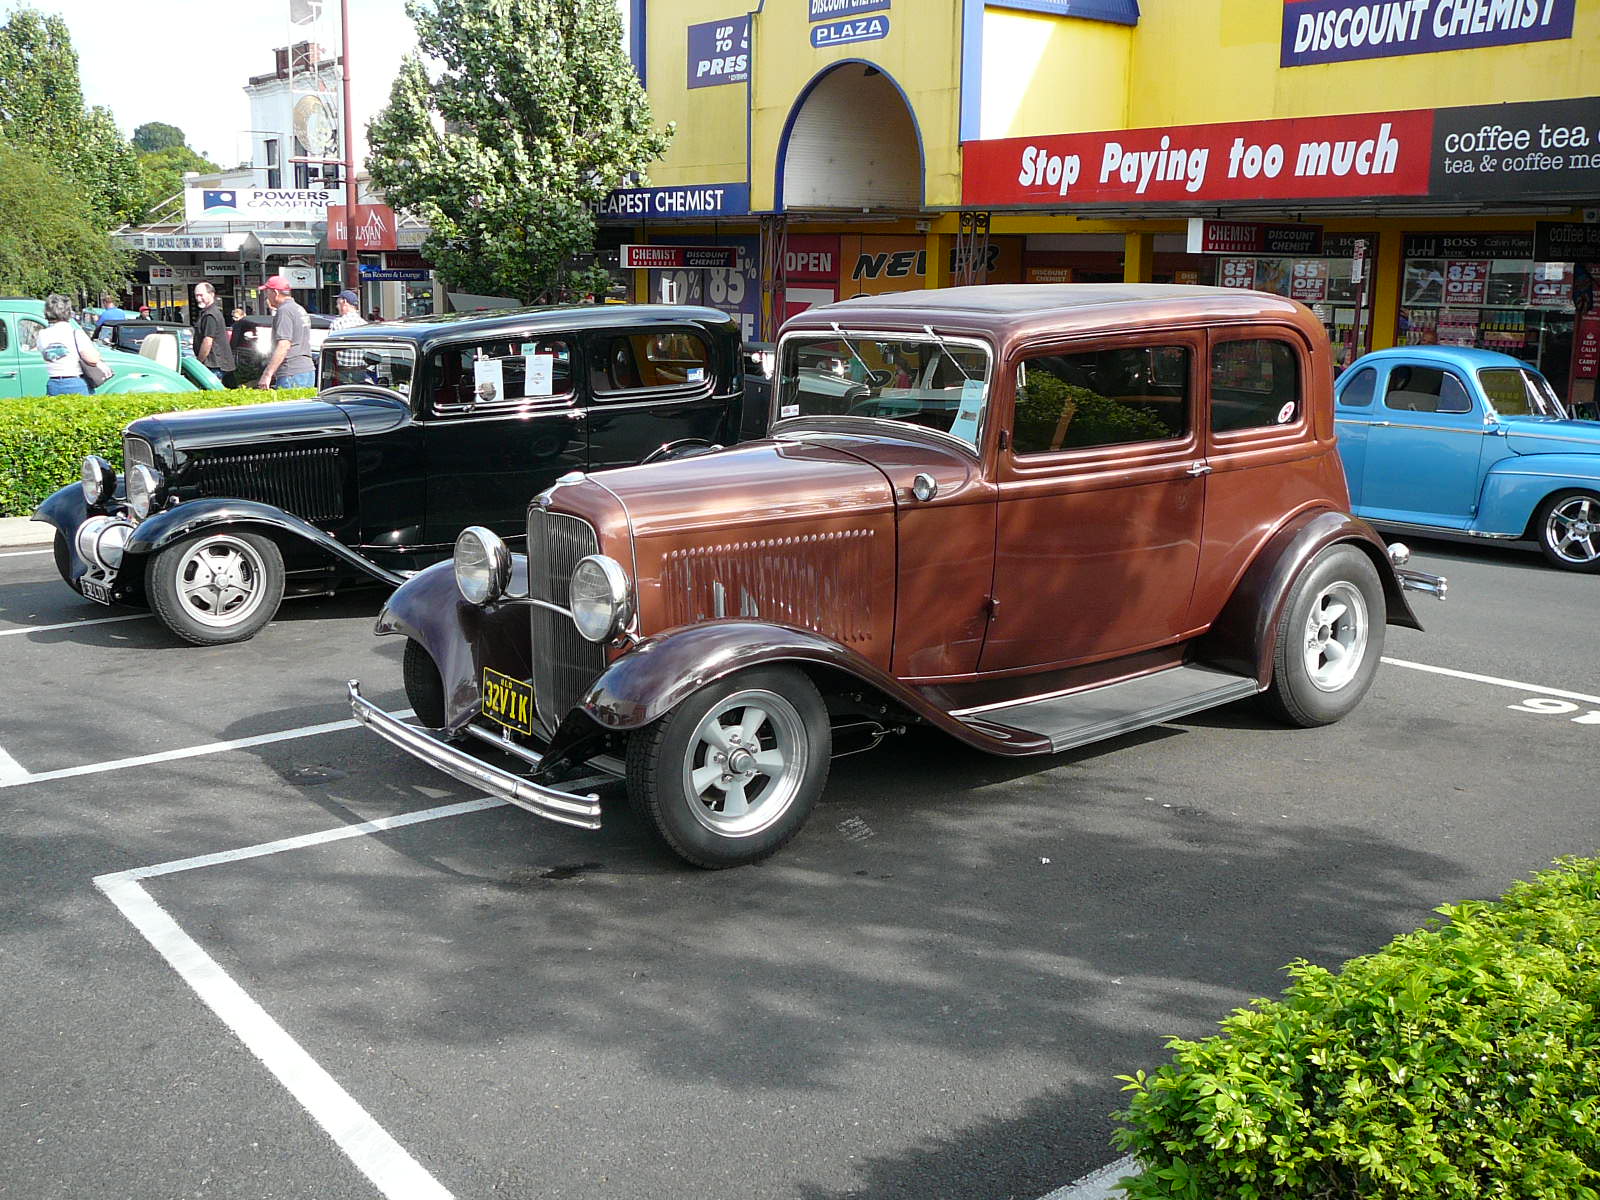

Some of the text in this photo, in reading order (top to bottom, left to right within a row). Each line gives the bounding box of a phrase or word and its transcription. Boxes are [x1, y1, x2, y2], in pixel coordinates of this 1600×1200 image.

[715, 26, 734, 40] UP
[816, 19, 882, 41] PLAZA
[1293, 0, 1554, 53] DISCOUNT CHEMIST
[715, 39, 732, 52] TO
[696, 55, 748, 77] PRES
[1444, 125, 1531, 153] coffee
[1538, 123, 1590, 149] tea
[1018, 123, 1399, 196] Stop Paying too much
[1444, 157, 1475, 174] tea
[1479, 154, 1497, 173] &
[1502, 152, 1563, 172] coffee
[253, 191, 330, 200] POWERS
[582, 189, 724, 214] HEAPEST CHEMIST
[247, 200, 337, 208] CAMPING
[1208, 224, 1257, 242] CHEMIST
[1268, 230, 1316, 240] DISCOUNT
[1271, 241, 1312, 251] CHEMIST
[1442, 238, 1478, 247] BOSS
[632, 248, 677, 261] CHEMIST
[686, 250, 730, 259] DISCOUNT
[689, 258, 727, 266] CHEMIST
[785, 251, 832, 273] OPEN
[852, 250, 928, 281] NE
[1224, 277, 1252, 288] OFF
[1293, 278, 1324, 289] OFF
[1447, 282, 1483, 293] OFF
[485, 680, 529, 725] 32VIK
